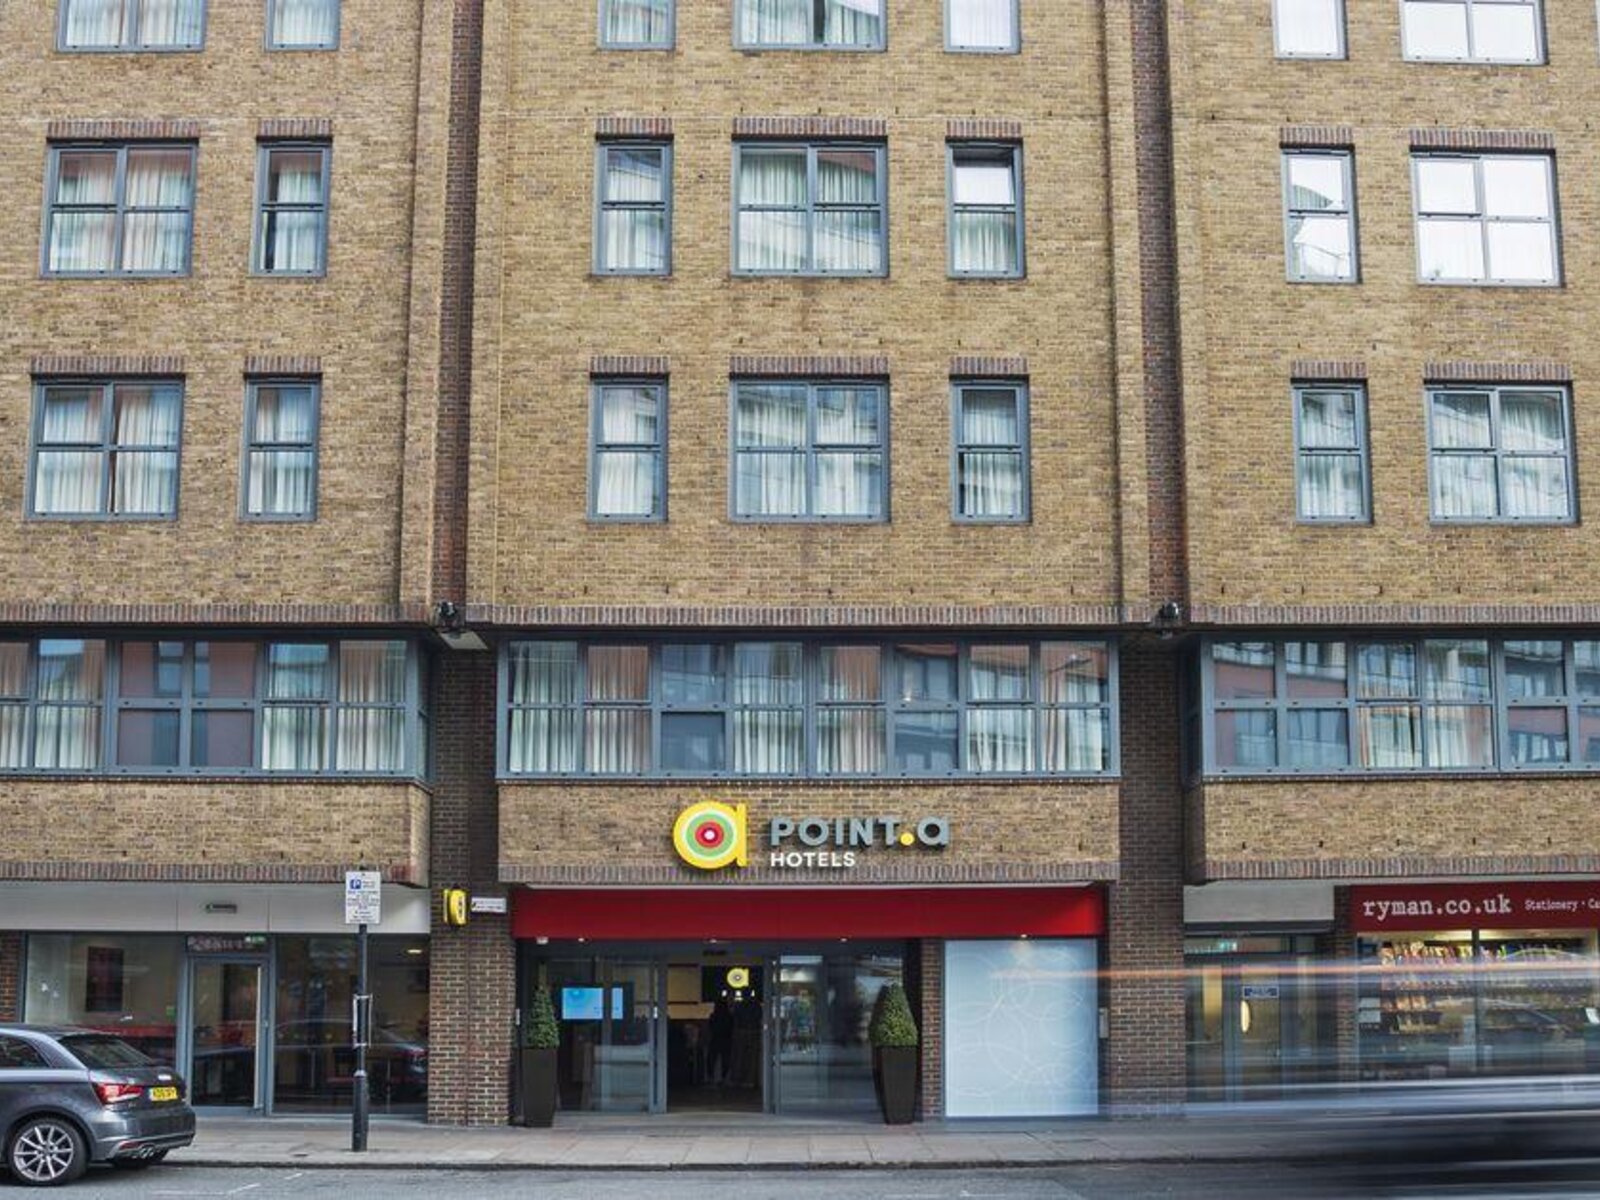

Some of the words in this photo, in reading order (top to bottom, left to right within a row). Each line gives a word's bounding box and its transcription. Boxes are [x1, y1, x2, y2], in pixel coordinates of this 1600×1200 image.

[770, 852, 855, 867] HOTELS
[1363, 895, 1512, 921] ryman.co.uk
[1525, 899, 1578, 912] Stationery
